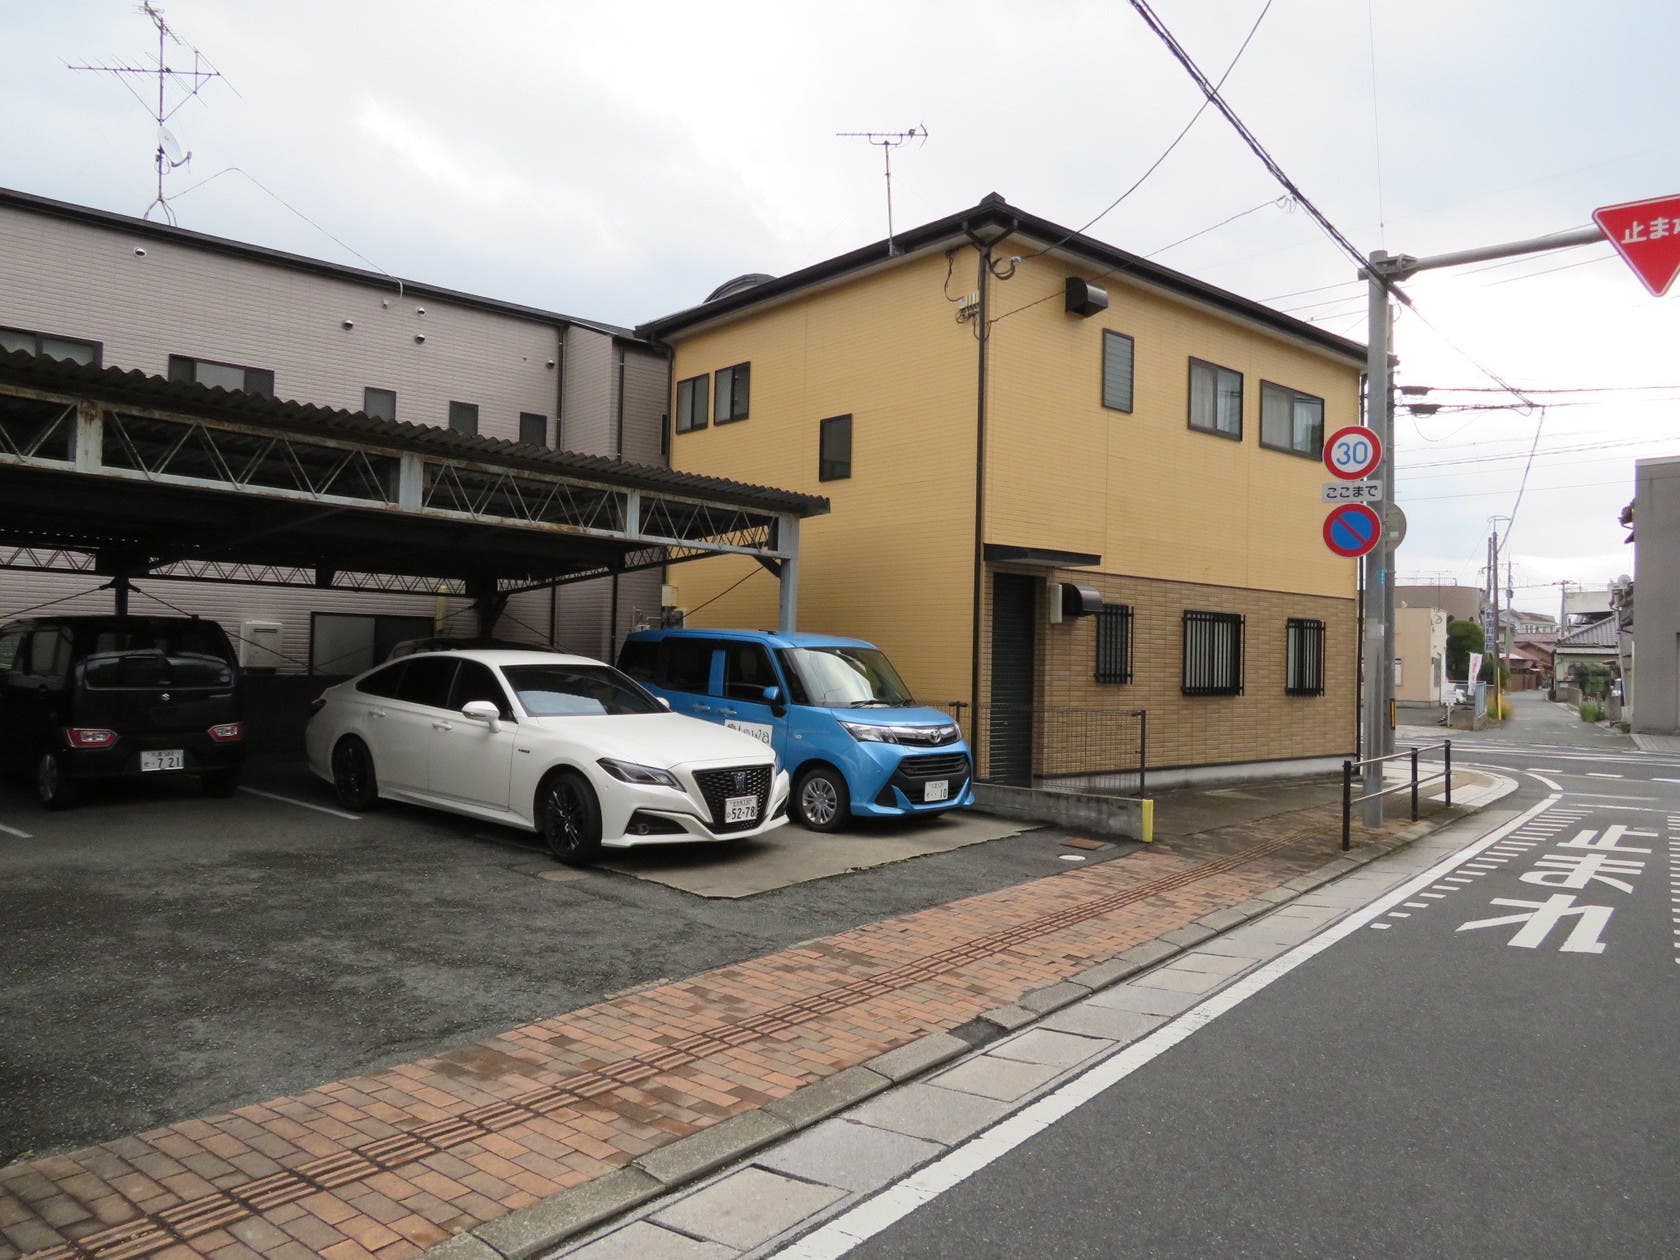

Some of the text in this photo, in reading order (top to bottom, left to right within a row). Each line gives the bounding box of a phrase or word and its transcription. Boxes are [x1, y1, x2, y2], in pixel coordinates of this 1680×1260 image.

[1336, 441, 1368, 465] 30
[1326, 485, 1378, 499] ここまで
[731, 806, 755, 820] 52-78
[1455, 825, 1659, 954] 止まれ
